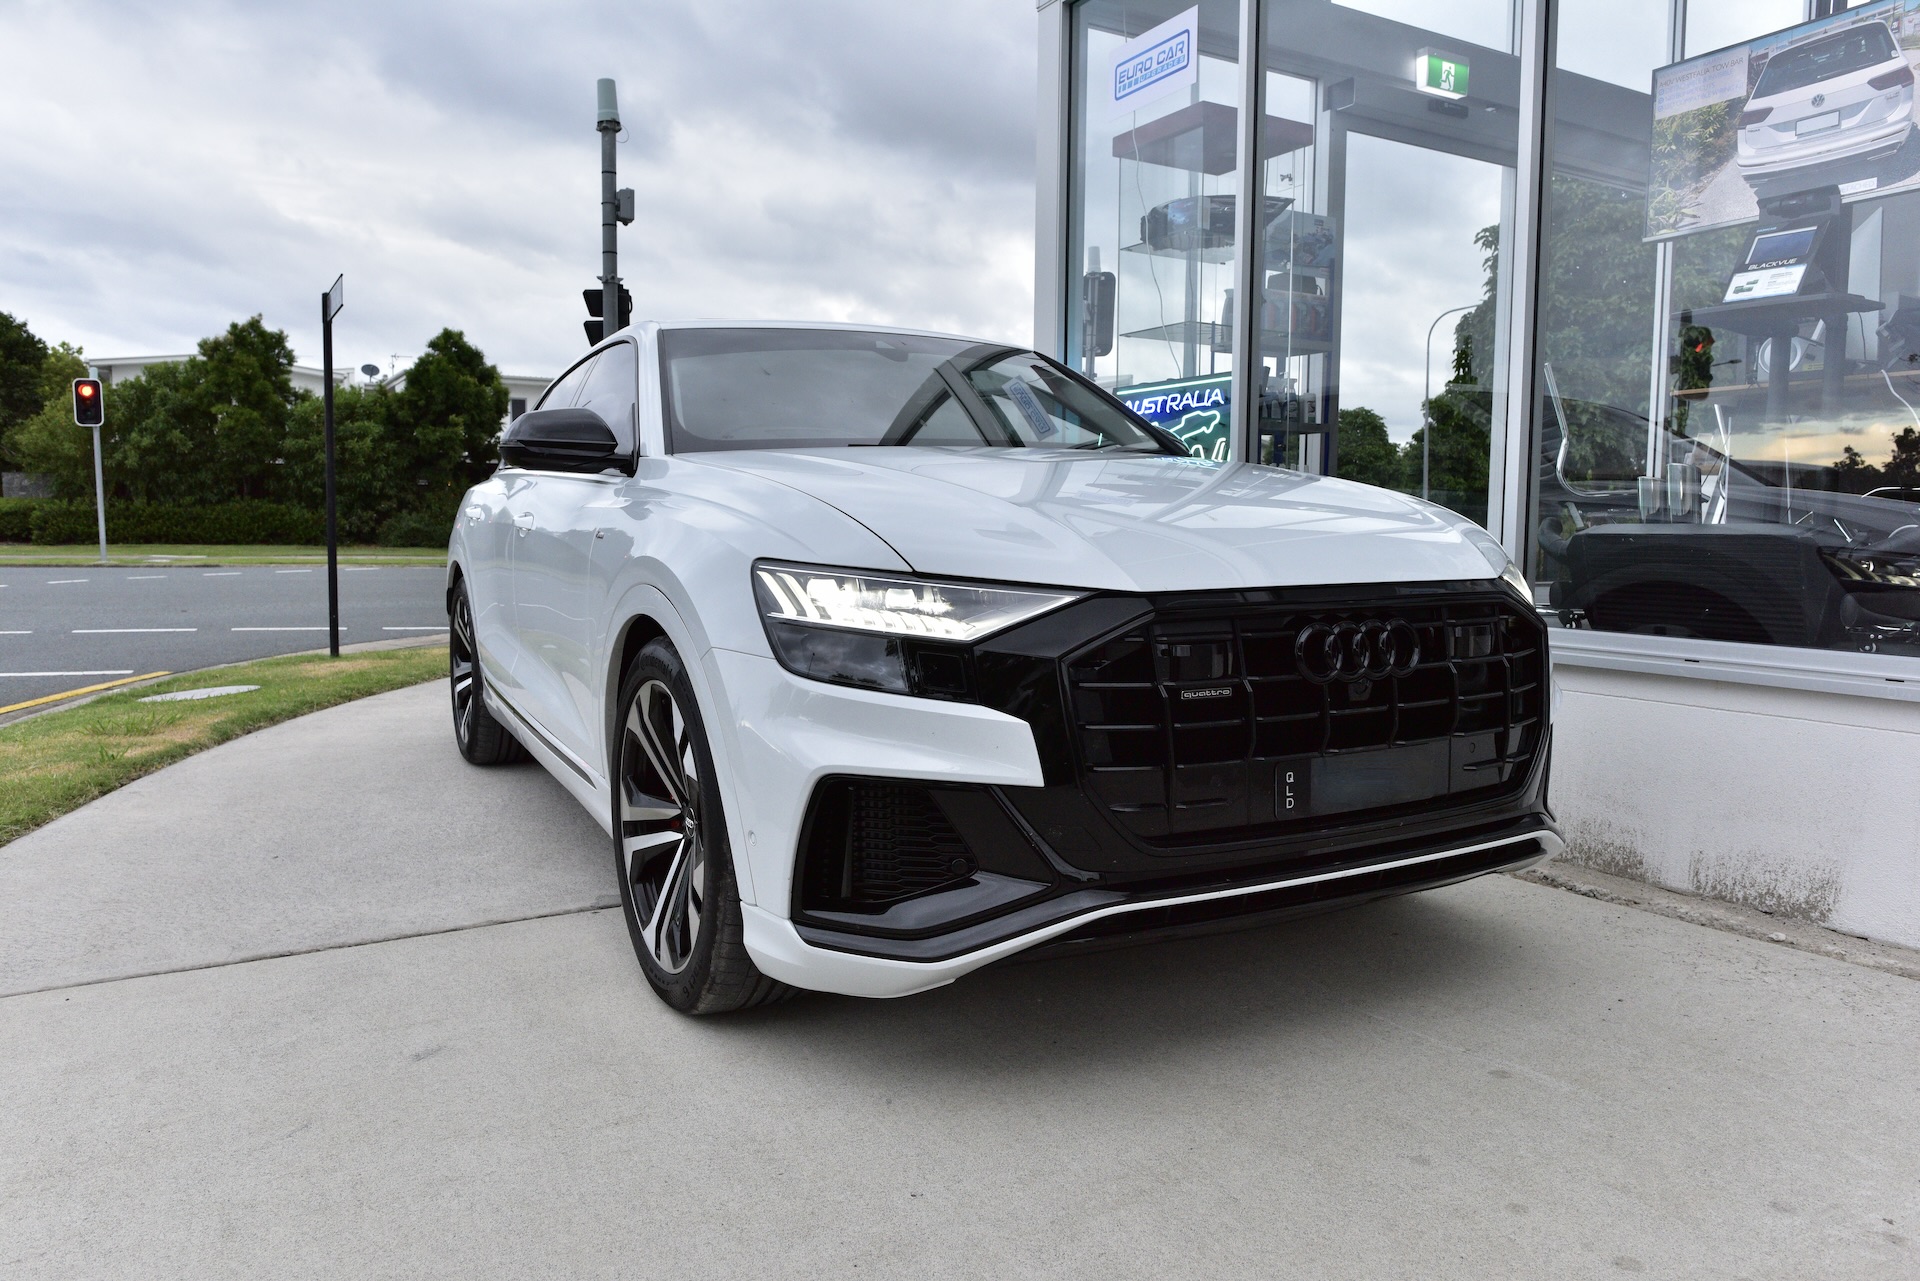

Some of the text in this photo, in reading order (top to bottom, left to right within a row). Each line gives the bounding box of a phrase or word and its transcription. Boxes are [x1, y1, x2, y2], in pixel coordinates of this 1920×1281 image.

[1119, 40, 1185, 85] EURO CAR
[1140, 54, 1186, 83] UPGRADES
[1712, 61, 1730, 72] TOW
[1731, 57, 1743, 67] BAR
[1747, 257, 1798, 271] BLACKVUE
[1125, 387, 1225, 416] AUSTRALIA
[1183, 688, 1230, 699] quattro
[1285, 771, 1295, 809] QLD
